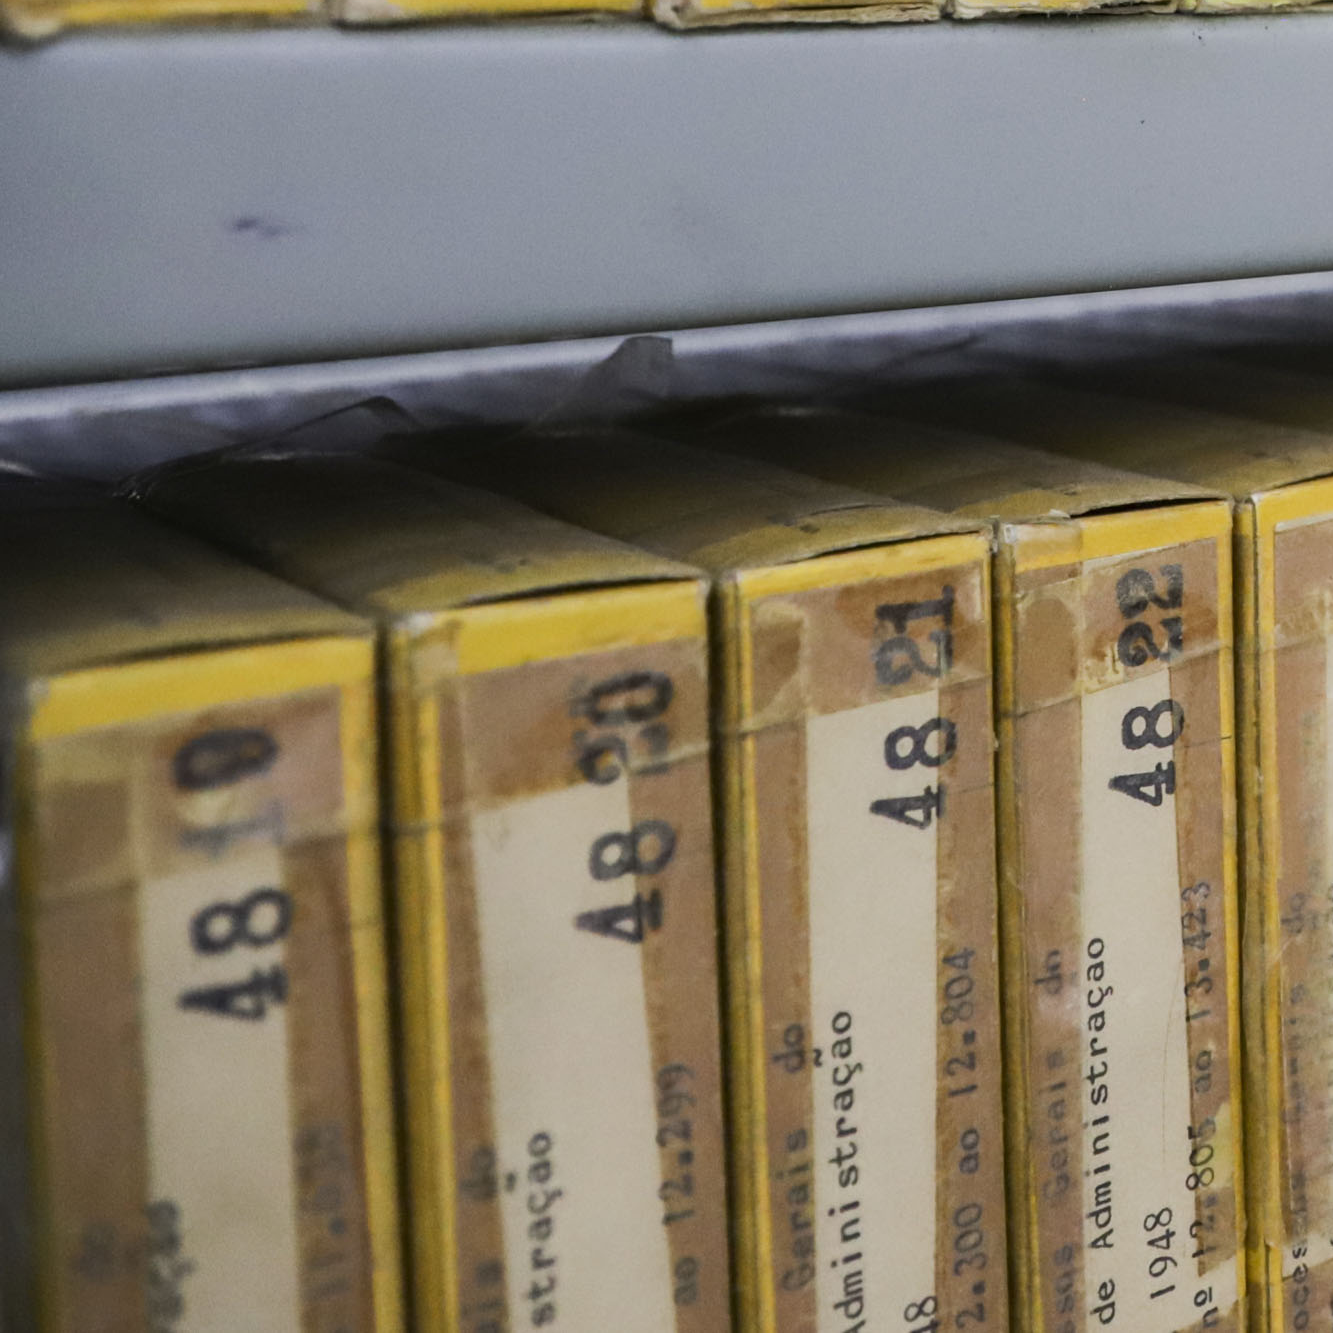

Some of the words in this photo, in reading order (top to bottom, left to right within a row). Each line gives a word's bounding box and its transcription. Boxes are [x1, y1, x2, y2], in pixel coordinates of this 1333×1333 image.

[867, 582, 958, 688] 21
[1114, 561, 1185, 669] 22
[866, 715, 959, 830] 48
[1106, 697, 1187, 807] 48
[570, 818, 680, 947] 48
[174, 887, 294, 1023] 48
[1180, 880, 1213, 1027] 13.423
[770, 1022, 808, 1076] do
[938, 947, 981, 1101] 12.804
[1192, 1047, 1214, 1096] ao
[1040, 1049, 1072, 1206] Gerais
[1078, 936, 1116, 1253] Administração
[956, 1127, 982, 1176] ao
[1186, 1115, 1220, 1261] 12.805
[772, 1127, 816, 1294] Gerais
[1141, 1205, 1180, 1302] 1948
[670, 1254, 702, 1308] ao
[1088, 1276, 1118, 1326] de
[1191, 1284, 1224, 1331] nº
